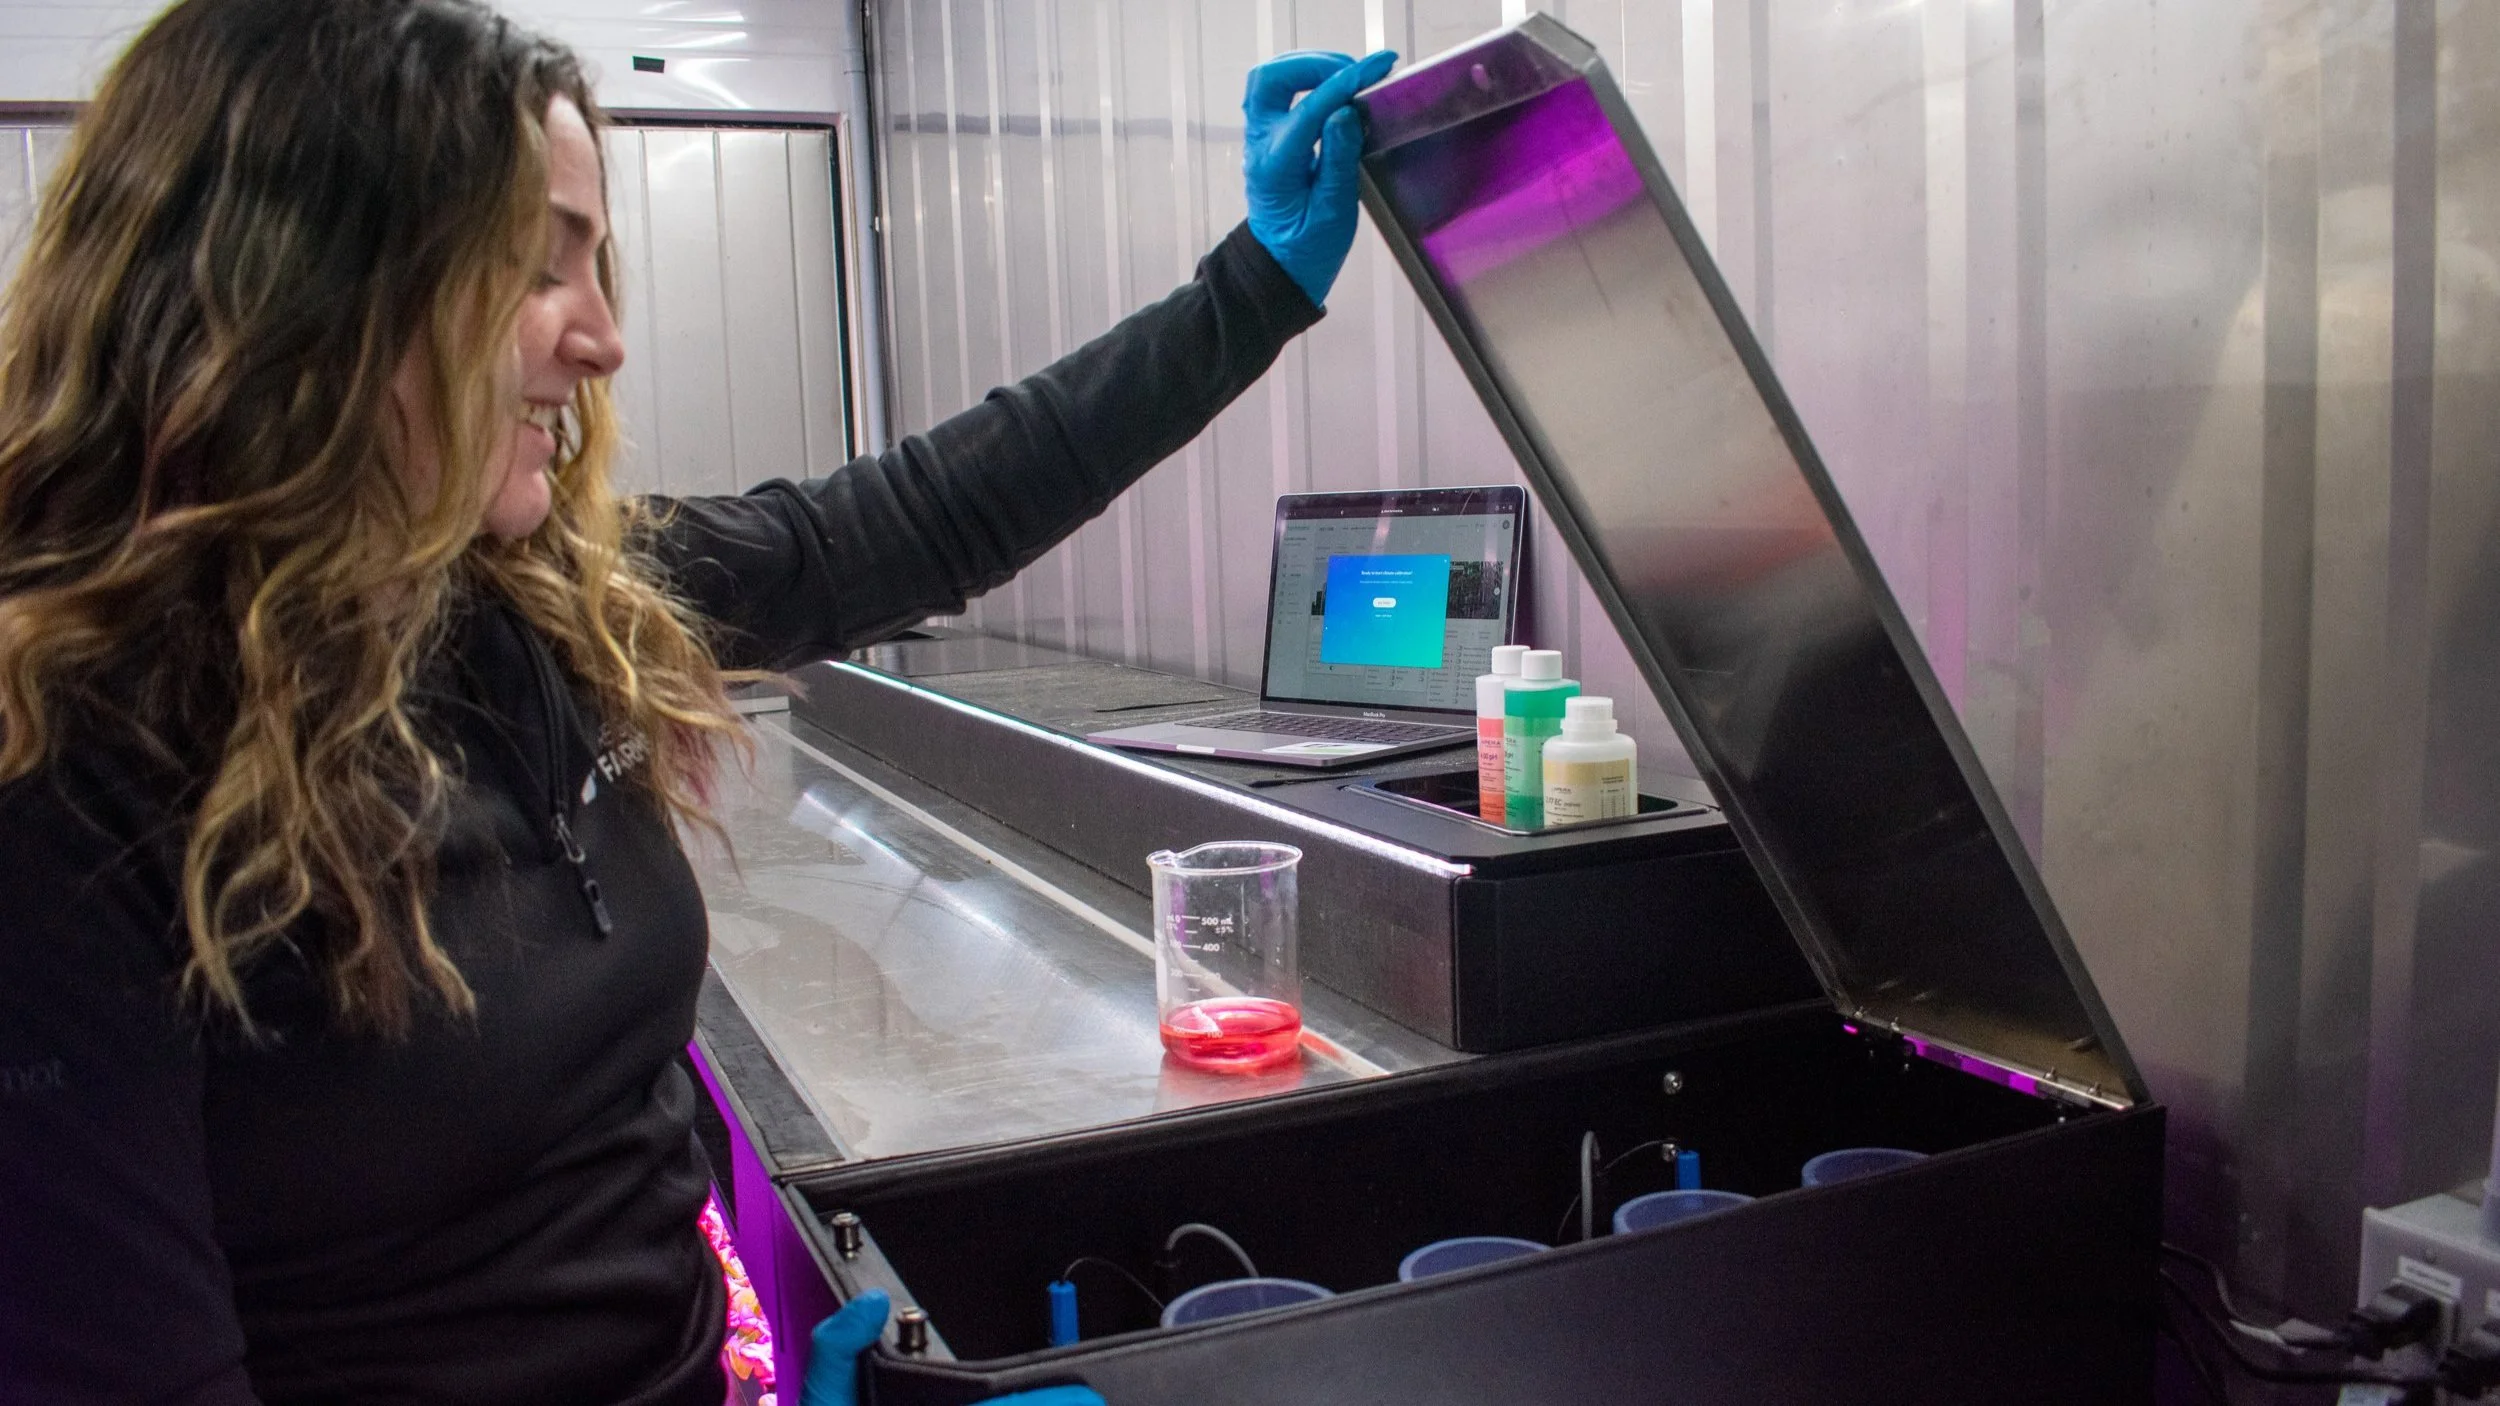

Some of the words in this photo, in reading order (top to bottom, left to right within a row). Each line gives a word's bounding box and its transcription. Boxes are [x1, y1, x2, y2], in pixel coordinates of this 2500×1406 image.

[1201, 917, 1219, 926] 500
[1220, 917, 1234, 925] mL
[1202, 944, 1220, 953] 400
